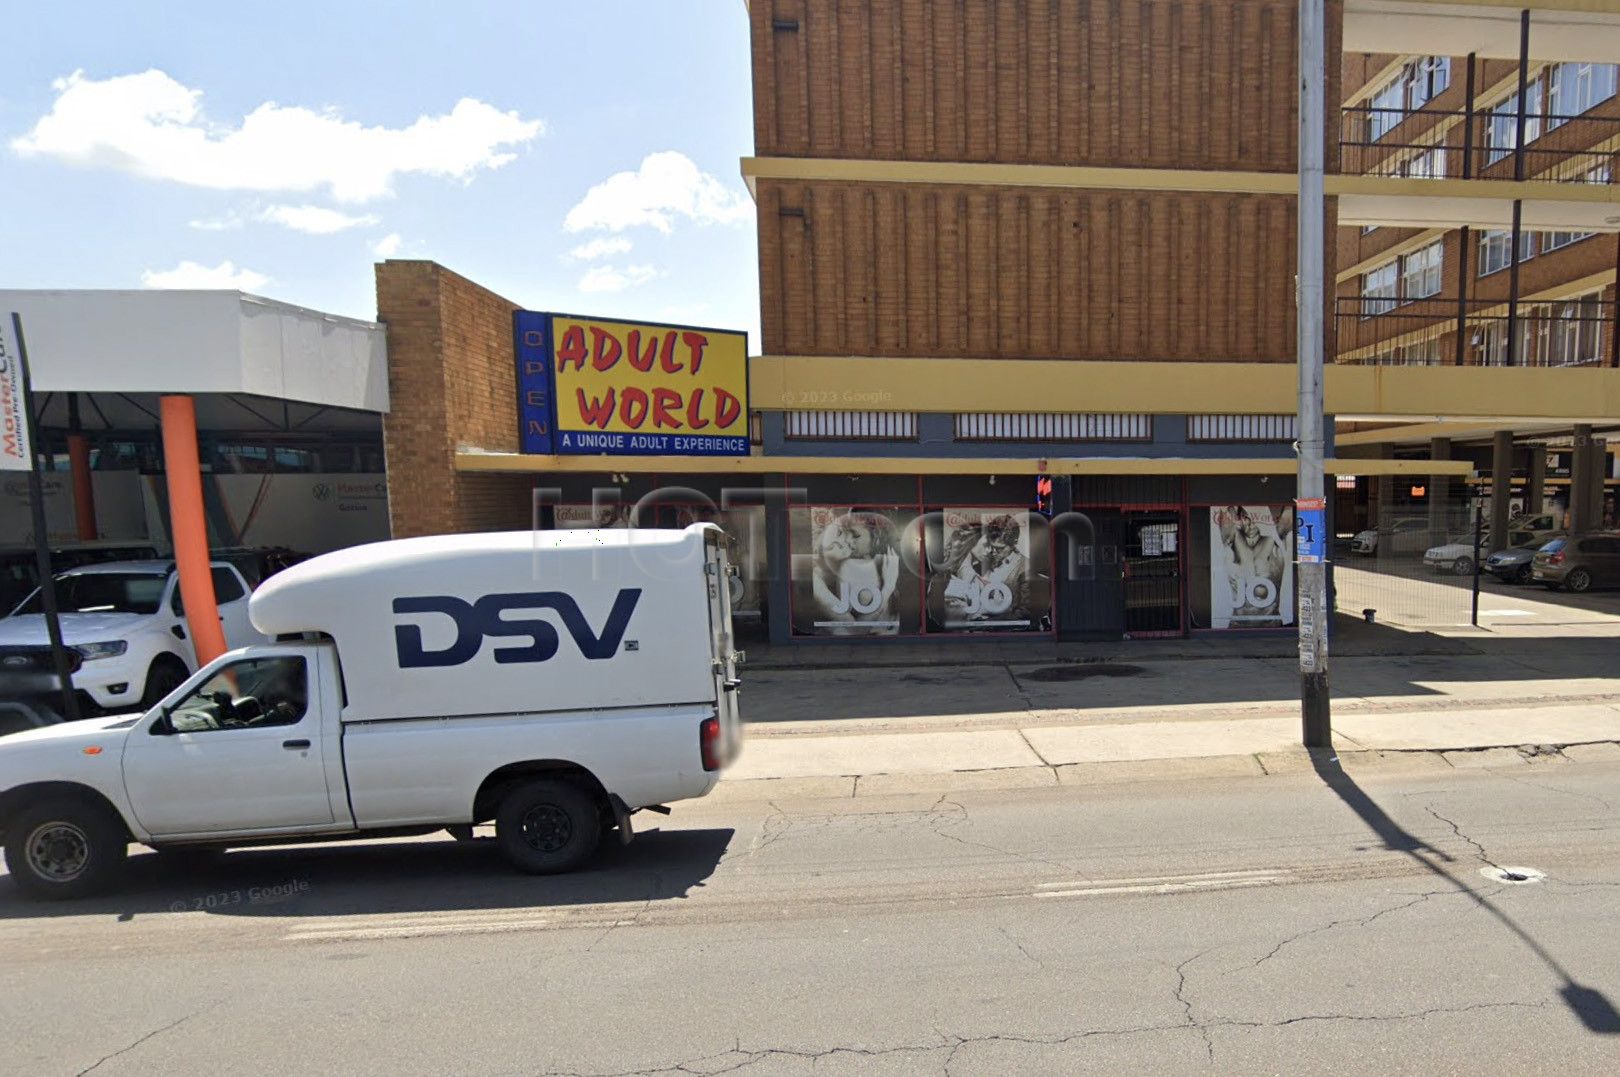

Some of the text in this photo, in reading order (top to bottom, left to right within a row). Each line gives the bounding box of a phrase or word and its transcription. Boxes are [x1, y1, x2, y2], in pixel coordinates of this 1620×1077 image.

[556, 324, 709, 375] ADULT
[523, 330, 548, 435] OPEN
[575, 386, 741, 429] WORLD
[562, 434, 745, 451] A UNIQUE ADULT EXPERIENCE
[392, 588, 643, 668] DSV
